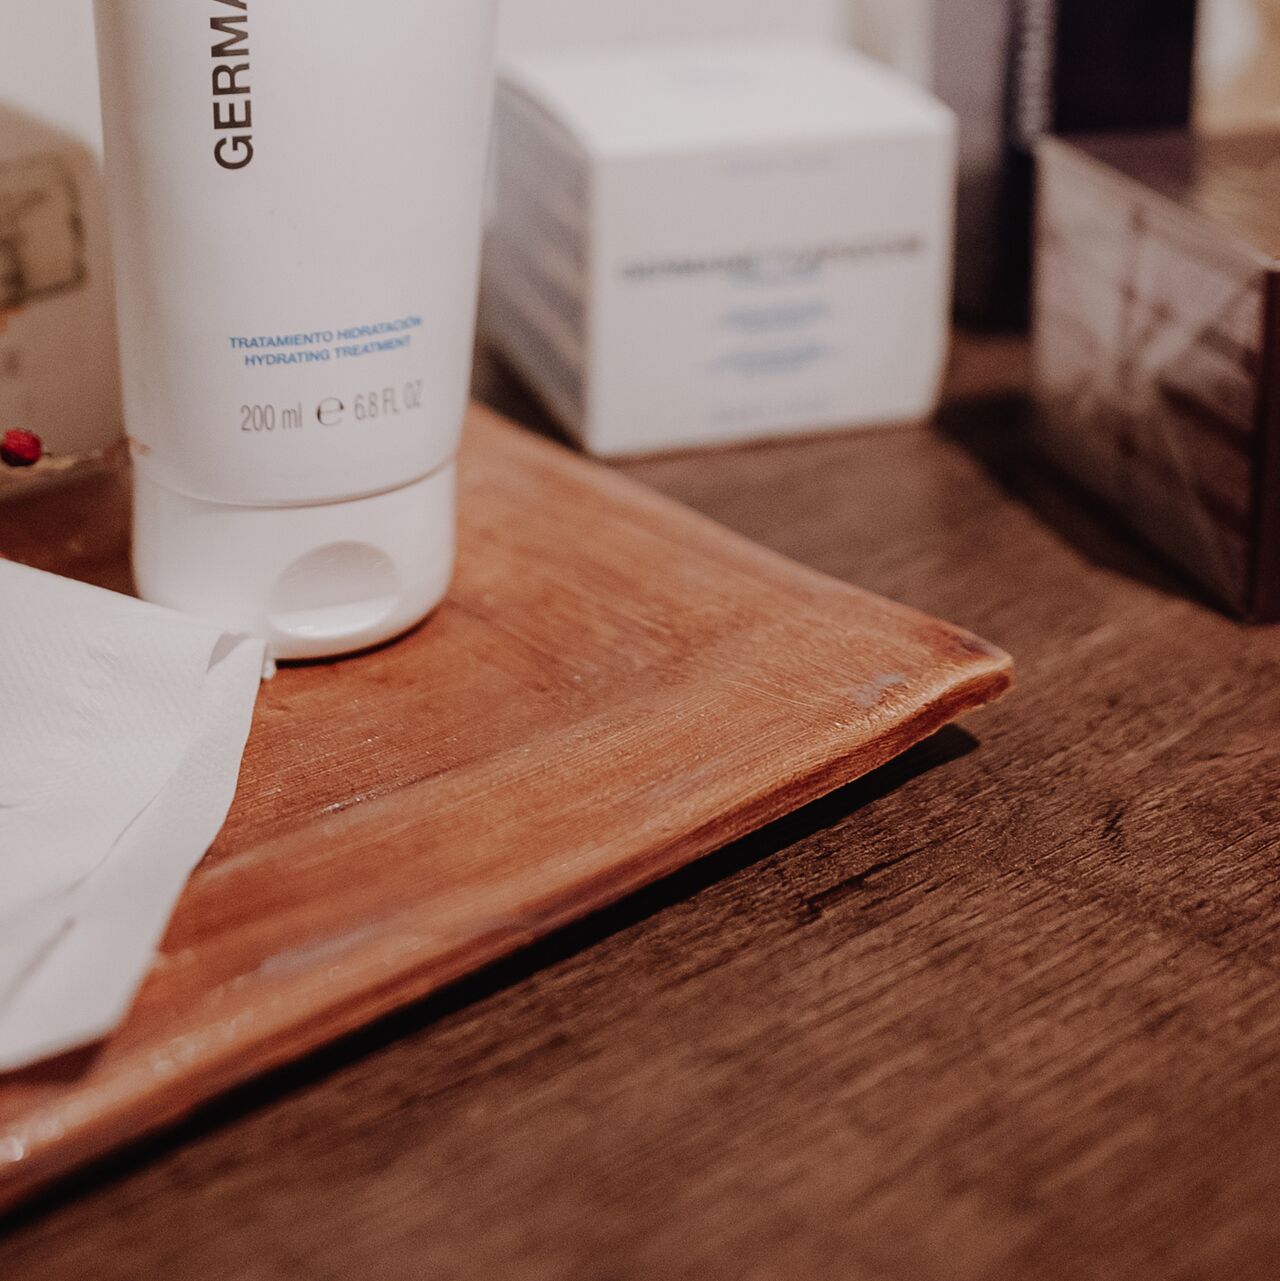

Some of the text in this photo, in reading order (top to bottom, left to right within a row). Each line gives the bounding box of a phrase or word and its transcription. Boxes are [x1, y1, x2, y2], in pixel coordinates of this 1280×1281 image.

[229, 331, 333, 349] TRATAMIENTO
[244, 336, 411, 367] HYDRATING TREATMENT
[240, 404, 276, 433] 200
[281, 402, 303, 430] ml
